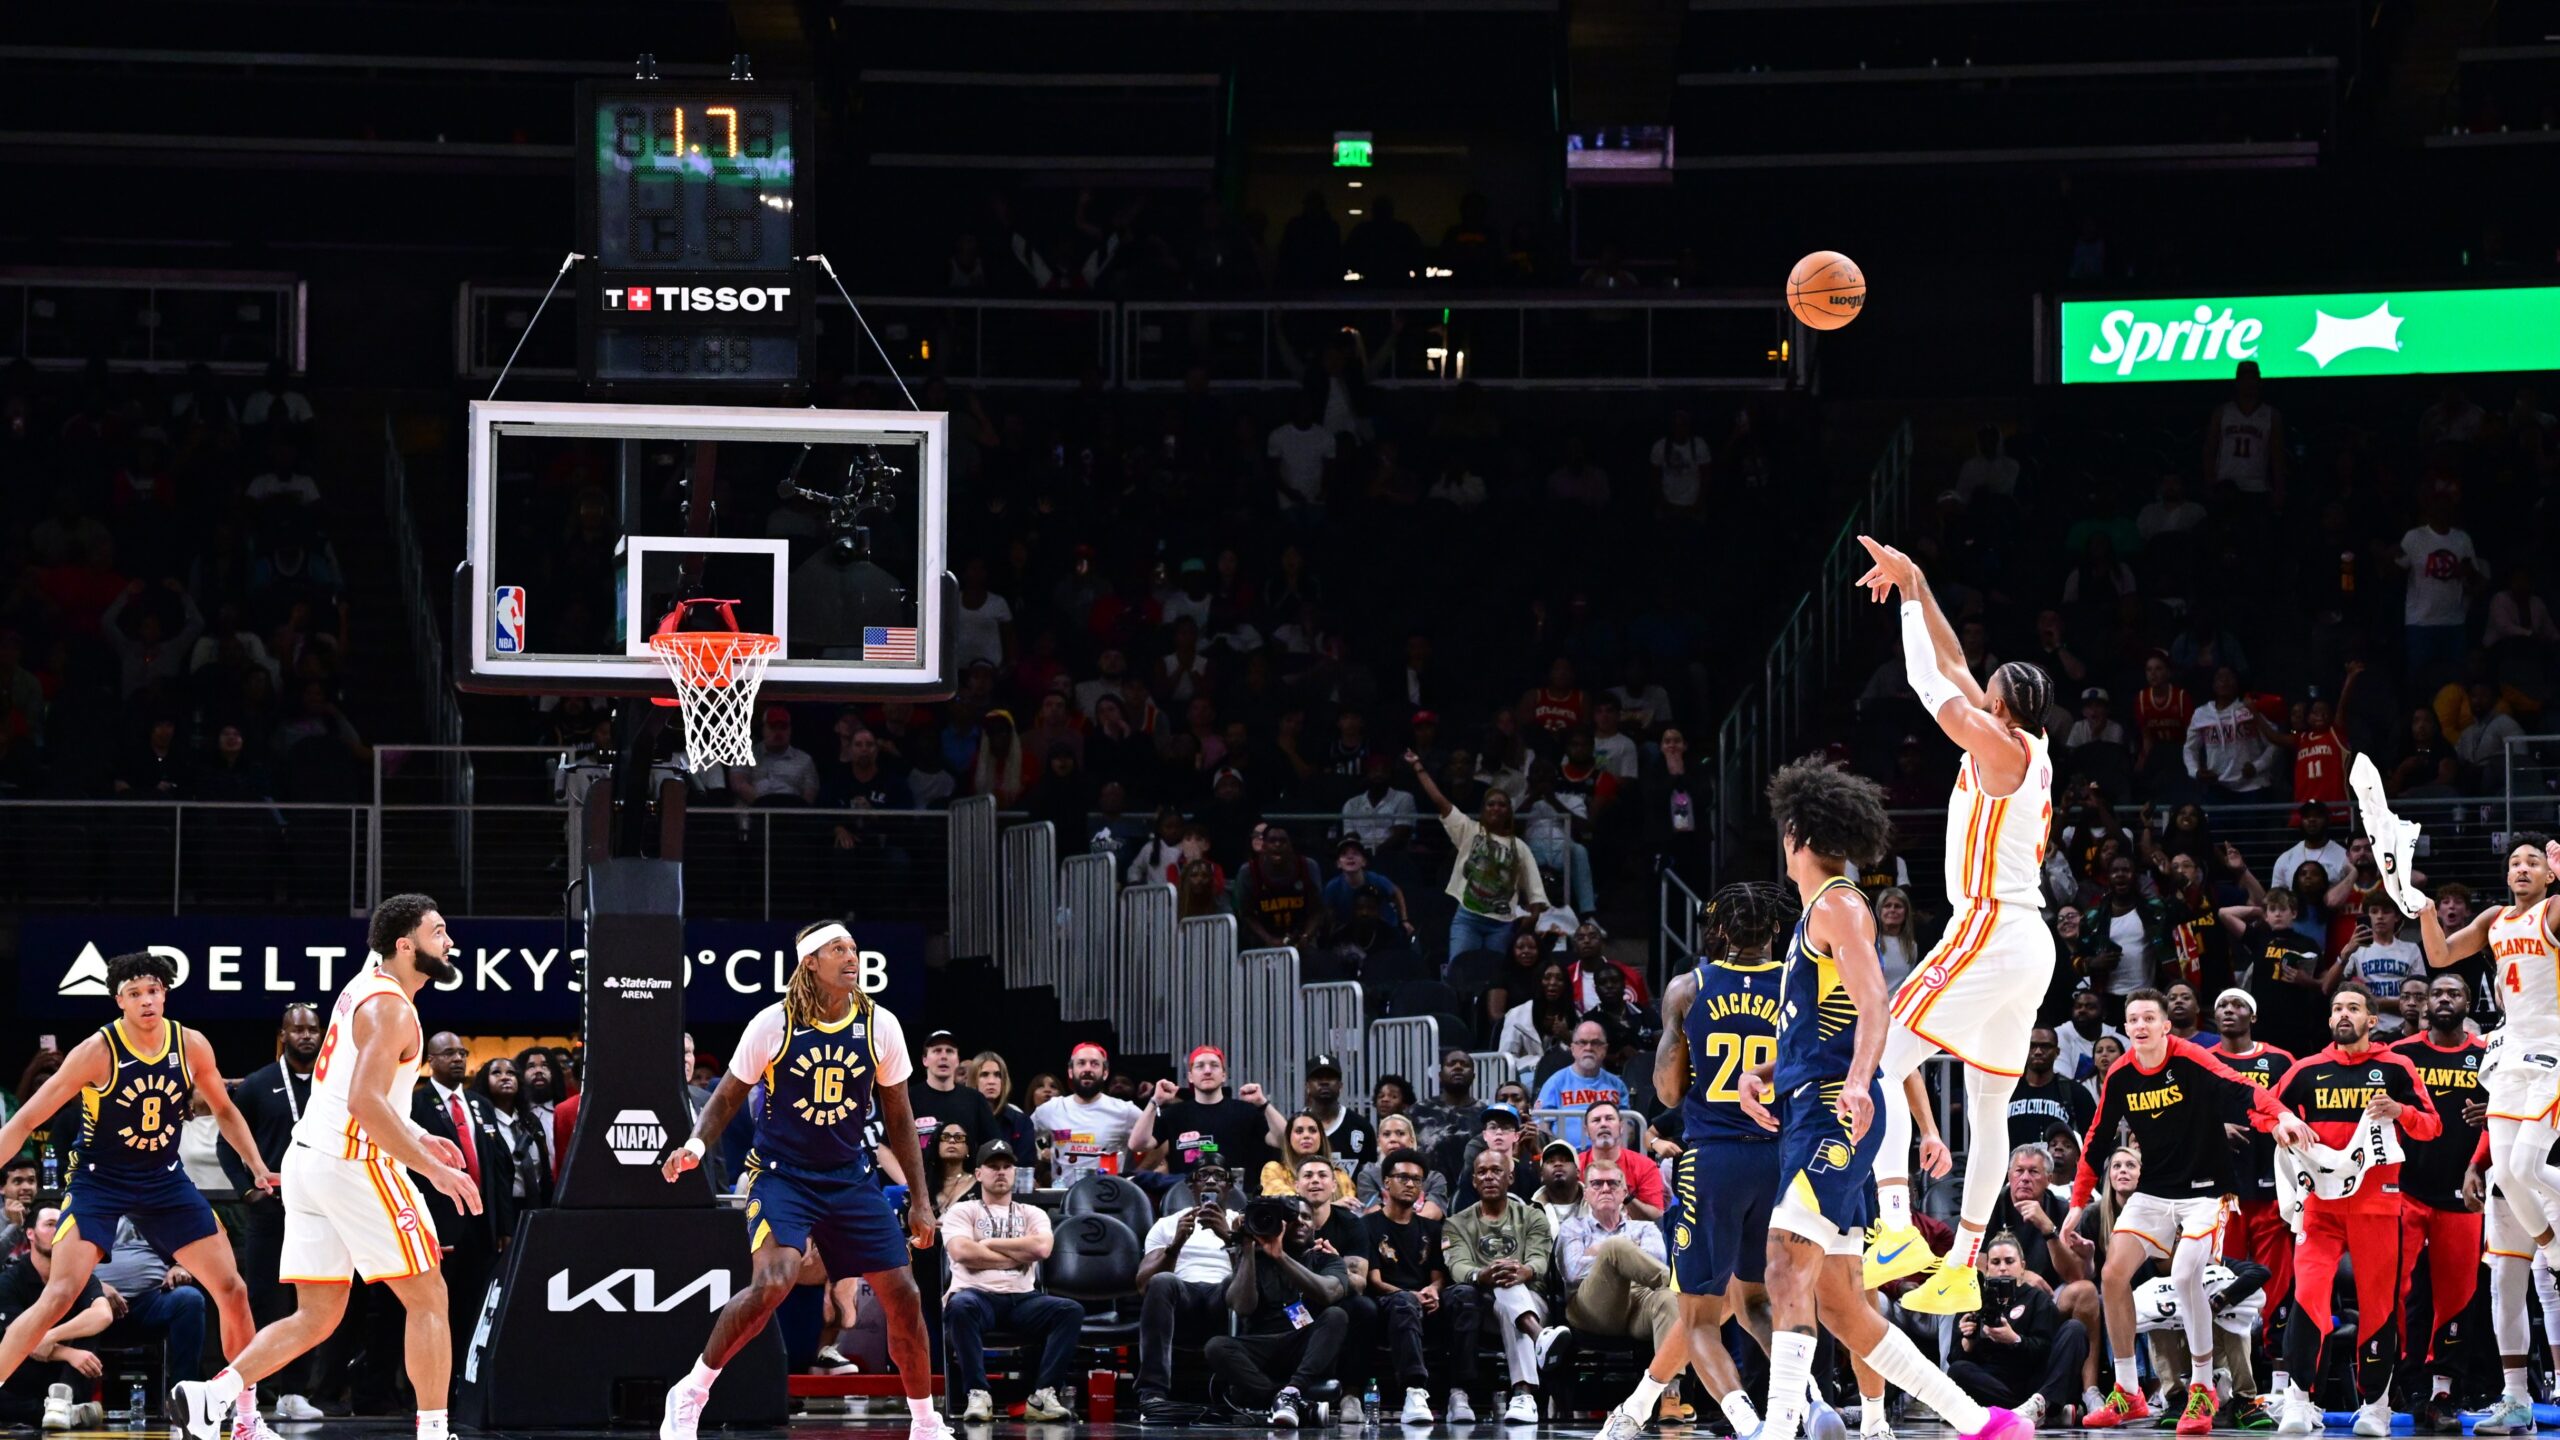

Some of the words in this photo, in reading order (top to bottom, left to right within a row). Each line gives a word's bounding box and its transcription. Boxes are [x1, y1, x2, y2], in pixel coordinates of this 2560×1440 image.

[675, 107, 737, 158] 1.7
[655, 286, 791, 312] TISSOT
[2089, 304, 2263, 376] Sprite
[498, 637, 514, 649] NBA
[2306, 760, 2323, 779] 11
[1259, 896, 1305, 912] HAWKS
[725, 949, 889, 994] CLB
[2505, 962, 2520, 993] 4
[621, 990, 654, 999] ARENA
[314, 1023, 339, 1082] 8
[789, 1044, 866, 1078] INDIANA
[115, 1074, 183, 1108] INDIANA
[813, 1066, 845, 1103] 16
[2416, 1067, 2478, 1089] HAWKS
[792, 1097, 858, 1126] PACERS
[1561, 1089, 1621, 1106] HAWKS
[2126, 1084, 2184, 1112] HAWKS
[141, 1096, 161, 1132] 8
[117, 1123, 176, 1152] PACERS
[615, 1125, 659, 1150] NAPA
[547, 1267, 731, 1313] KIA
